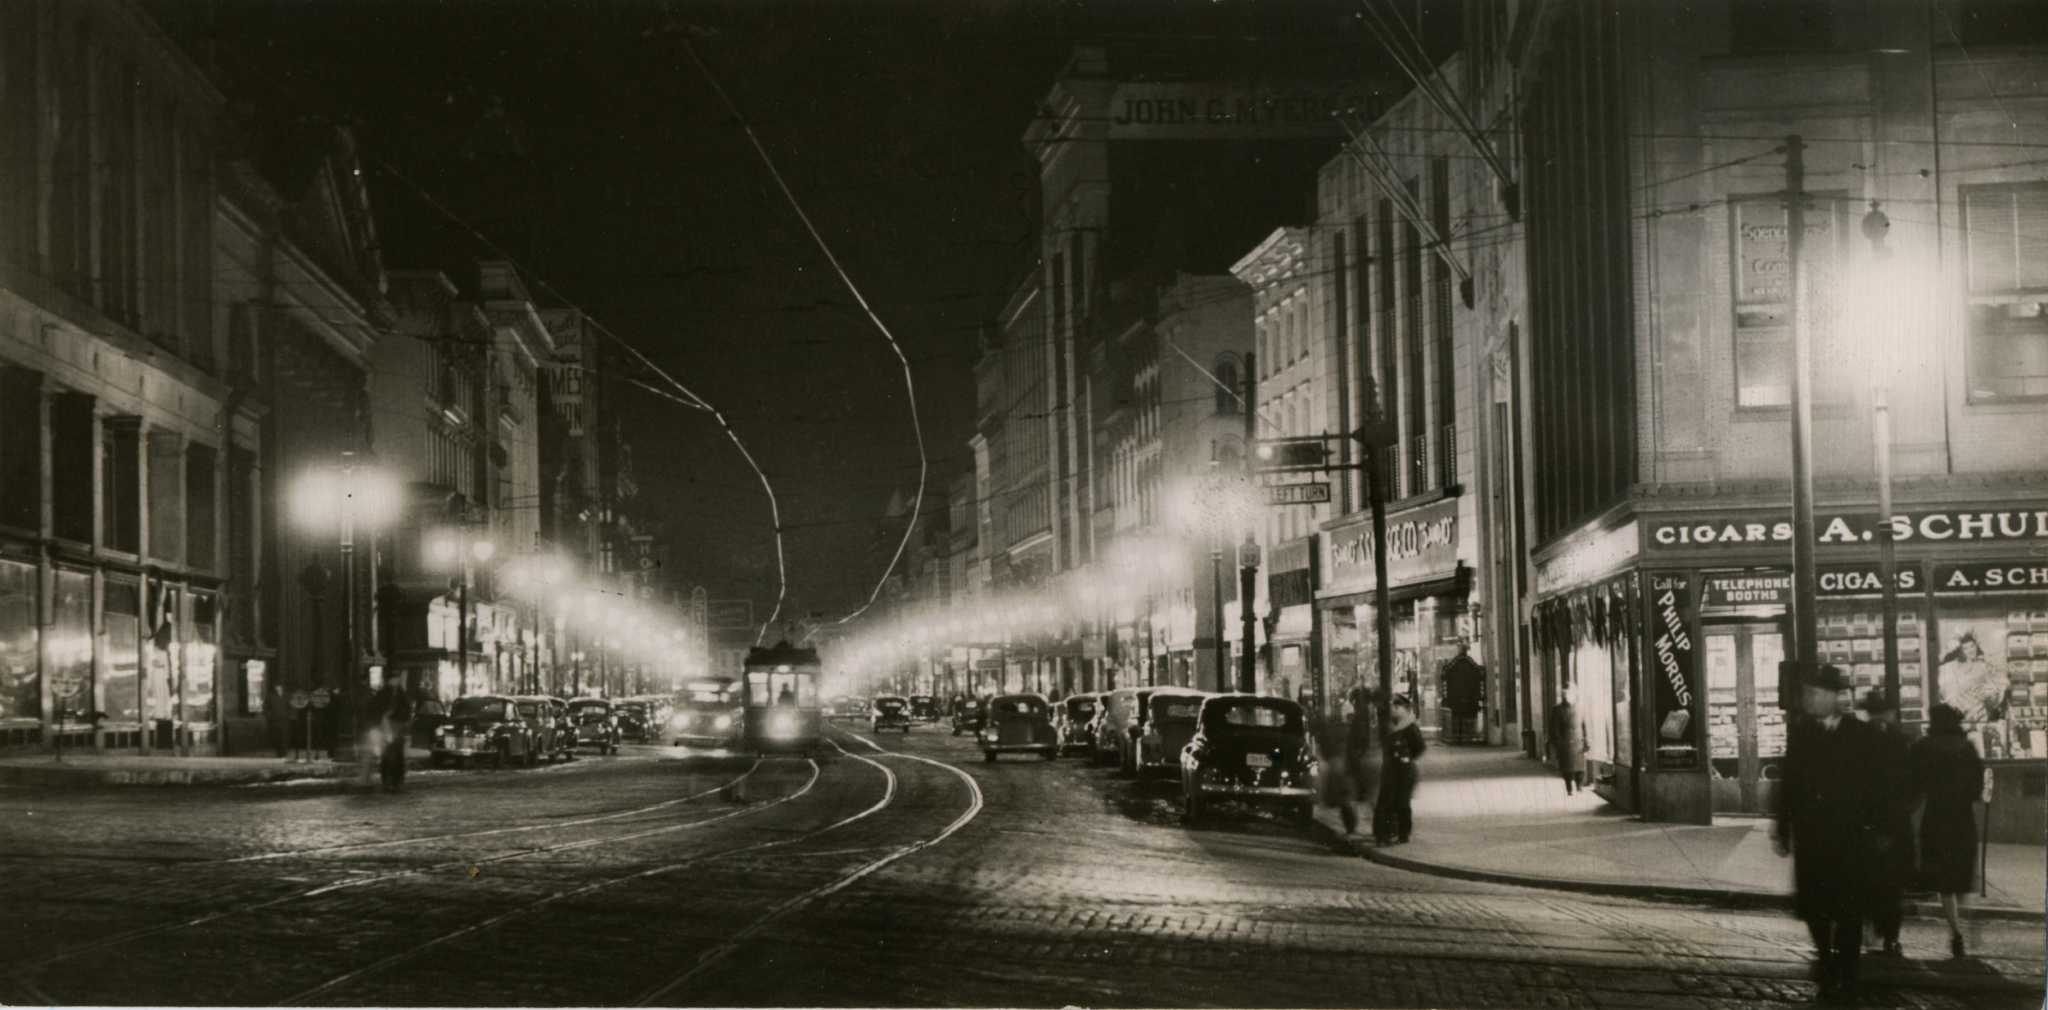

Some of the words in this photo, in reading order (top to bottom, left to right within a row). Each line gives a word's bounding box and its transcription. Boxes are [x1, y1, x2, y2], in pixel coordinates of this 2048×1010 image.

[1114, 99, 1196, 125] JOHN
[1299, 485, 1326, 500] TURN
[1655, 522, 1792, 545] CIGARS
[1818, 517, 1873, 542] A.
[1712, 577, 1790, 591] TELEPHONE
[1819, 571, 1915, 591] CIGAS
[1726, 590, 1779, 602] BOOTHS
[1657, 590, 1692, 651] PHILIP
[1655, 633, 1693, 707] MORRIS
